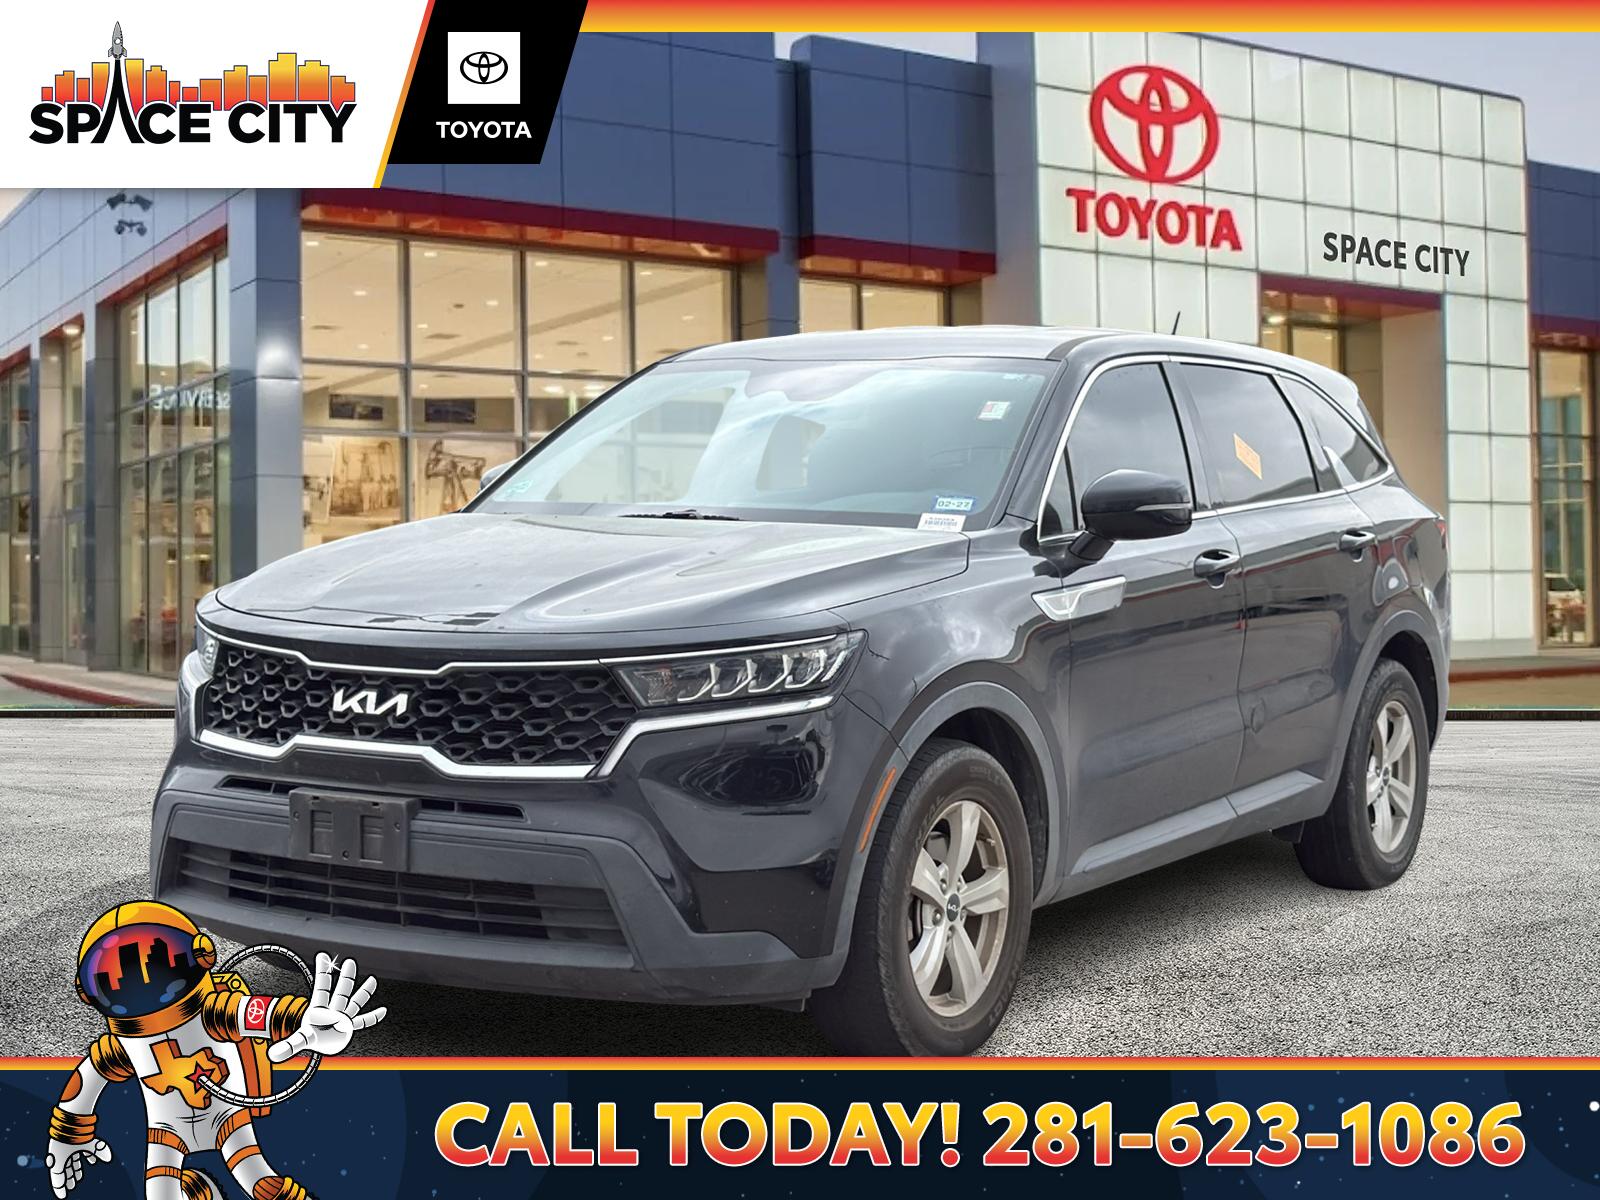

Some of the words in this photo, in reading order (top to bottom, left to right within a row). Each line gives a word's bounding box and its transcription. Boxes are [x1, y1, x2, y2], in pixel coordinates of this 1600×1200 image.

[1065, 188, 1243, 251] TOYOTA
[1323, 232, 1407, 269] SPACE
[1414, 244, 1470, 277] CITY
[332, 688, 409, 717] KIA
